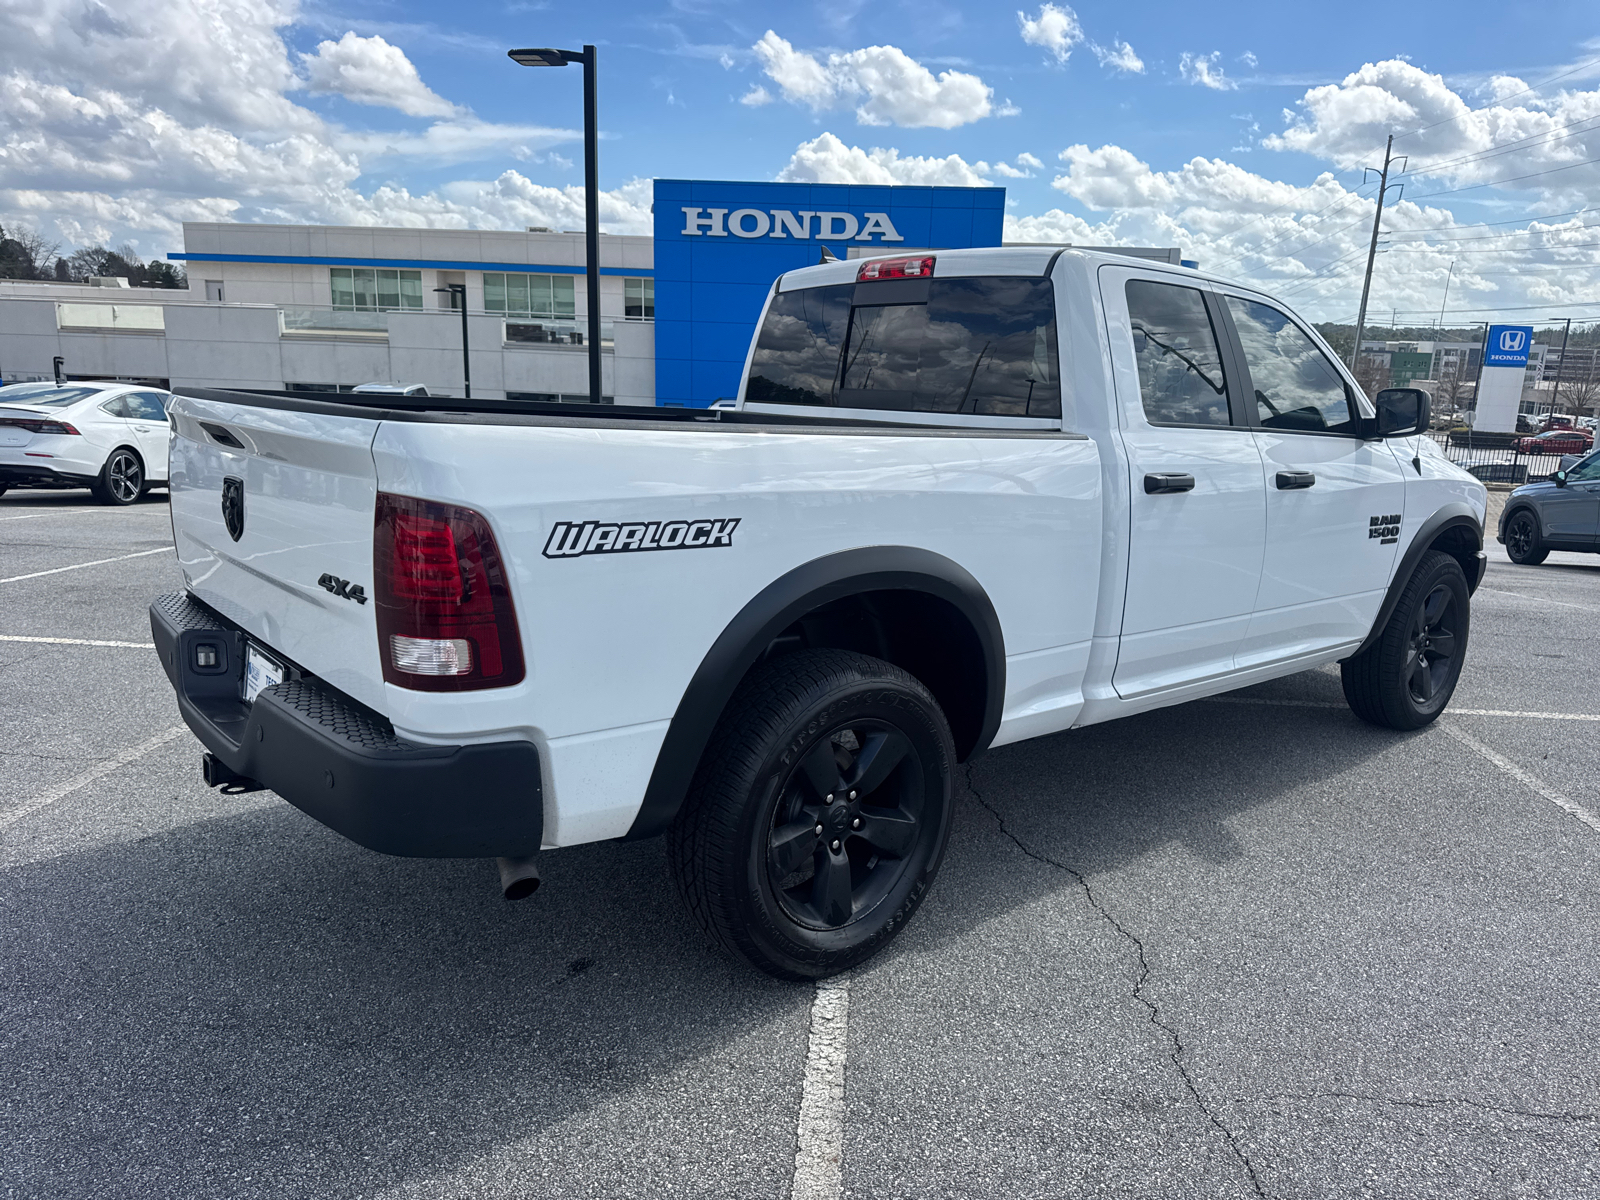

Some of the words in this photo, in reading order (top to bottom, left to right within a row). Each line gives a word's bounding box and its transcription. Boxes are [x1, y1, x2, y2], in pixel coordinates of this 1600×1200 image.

[681, 207, 904, 241] HONDA
[1368, 525, 1400, 539] 1500
[1369, 514, 1401, 527] RAM
[541, 517, 742, 559] WARLOCK
